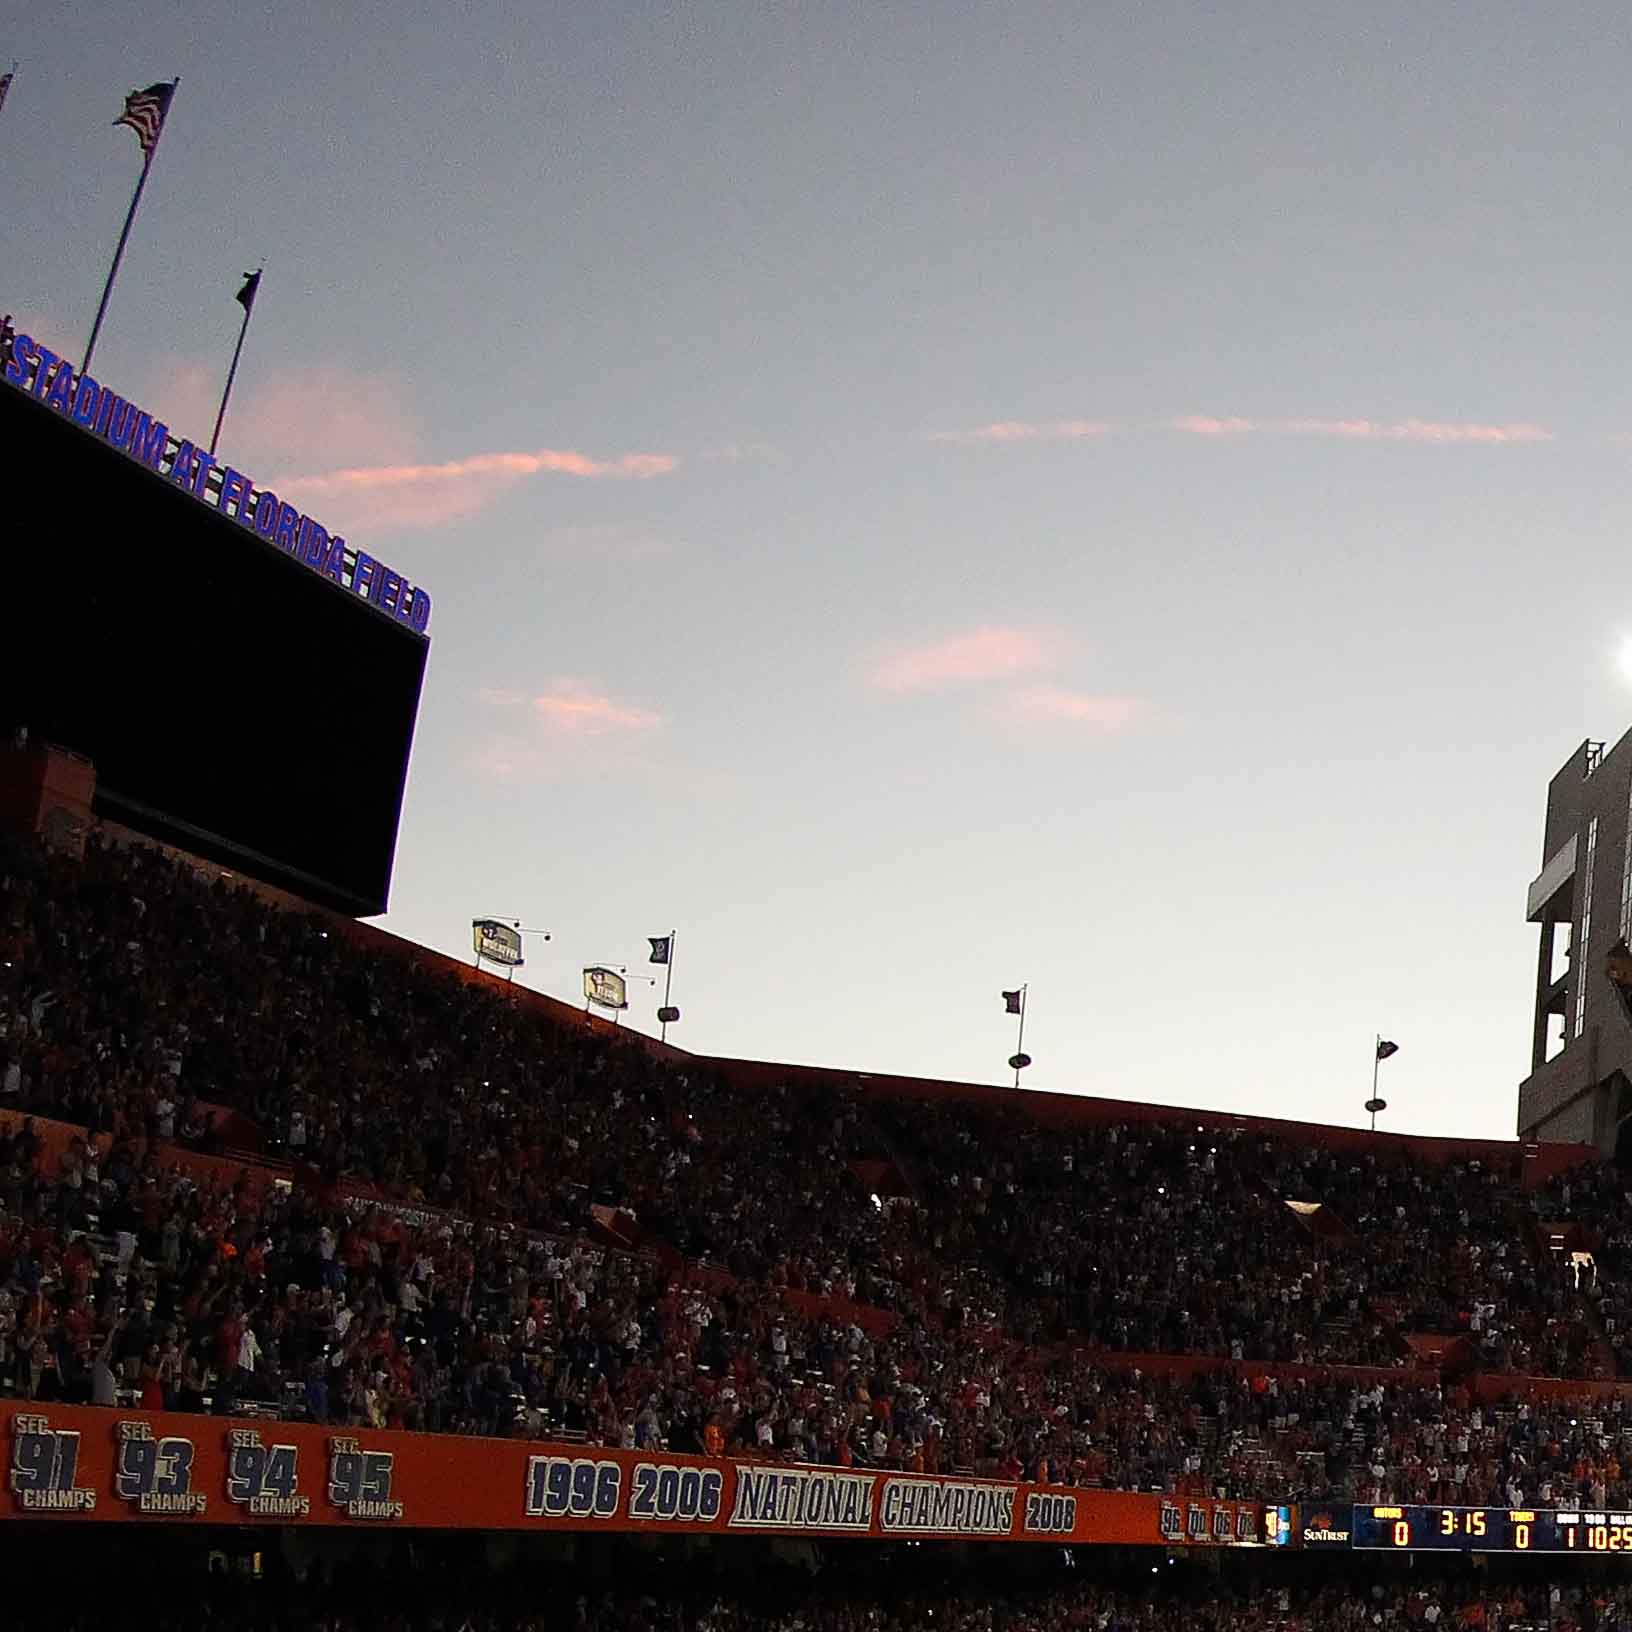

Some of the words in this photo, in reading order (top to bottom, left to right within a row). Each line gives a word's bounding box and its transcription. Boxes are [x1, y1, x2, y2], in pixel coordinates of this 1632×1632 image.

[5, 334, 168, 472] STADIUM
[171, 438, 217, 501] AT
[219, 466, 346, 586] FLORIDA
[351, 550, 432, 634] FIELD
[14, 1414, 49, 1436] SEC
[118, 1421, 153, 1441] SEC
[230, 1429, 261, 1448] SEC
[12, 1430, 81, 1493] 91
[116, 1435, 193, 1499] 93
[228, 1444, 298, 1502] 94
[329, 1450, 393, 1505] 95
[22, 1489, 97, 1511] CHAMPS
[139, 1492, 207, 1513] CHAMPS
[249, 1495, 310, 1516] CHAMPS
[526, 1455, 621, 1518] 1996
[629, 1462, 722, 1521] 2006
[728, 1464, 877, 1531] NATIONAL
[879, 1477, 1018, 1535] CHAMPIONS
[1023, 1493, 1077, 1532] 2008
[347, 1499, 404, 1518] CHAMPS
[1395, 1521, 1408, 1546] 0
[1440, 1510, 1486, 1536] 3:15
[1516, 1525, 1528, 1548] 0
